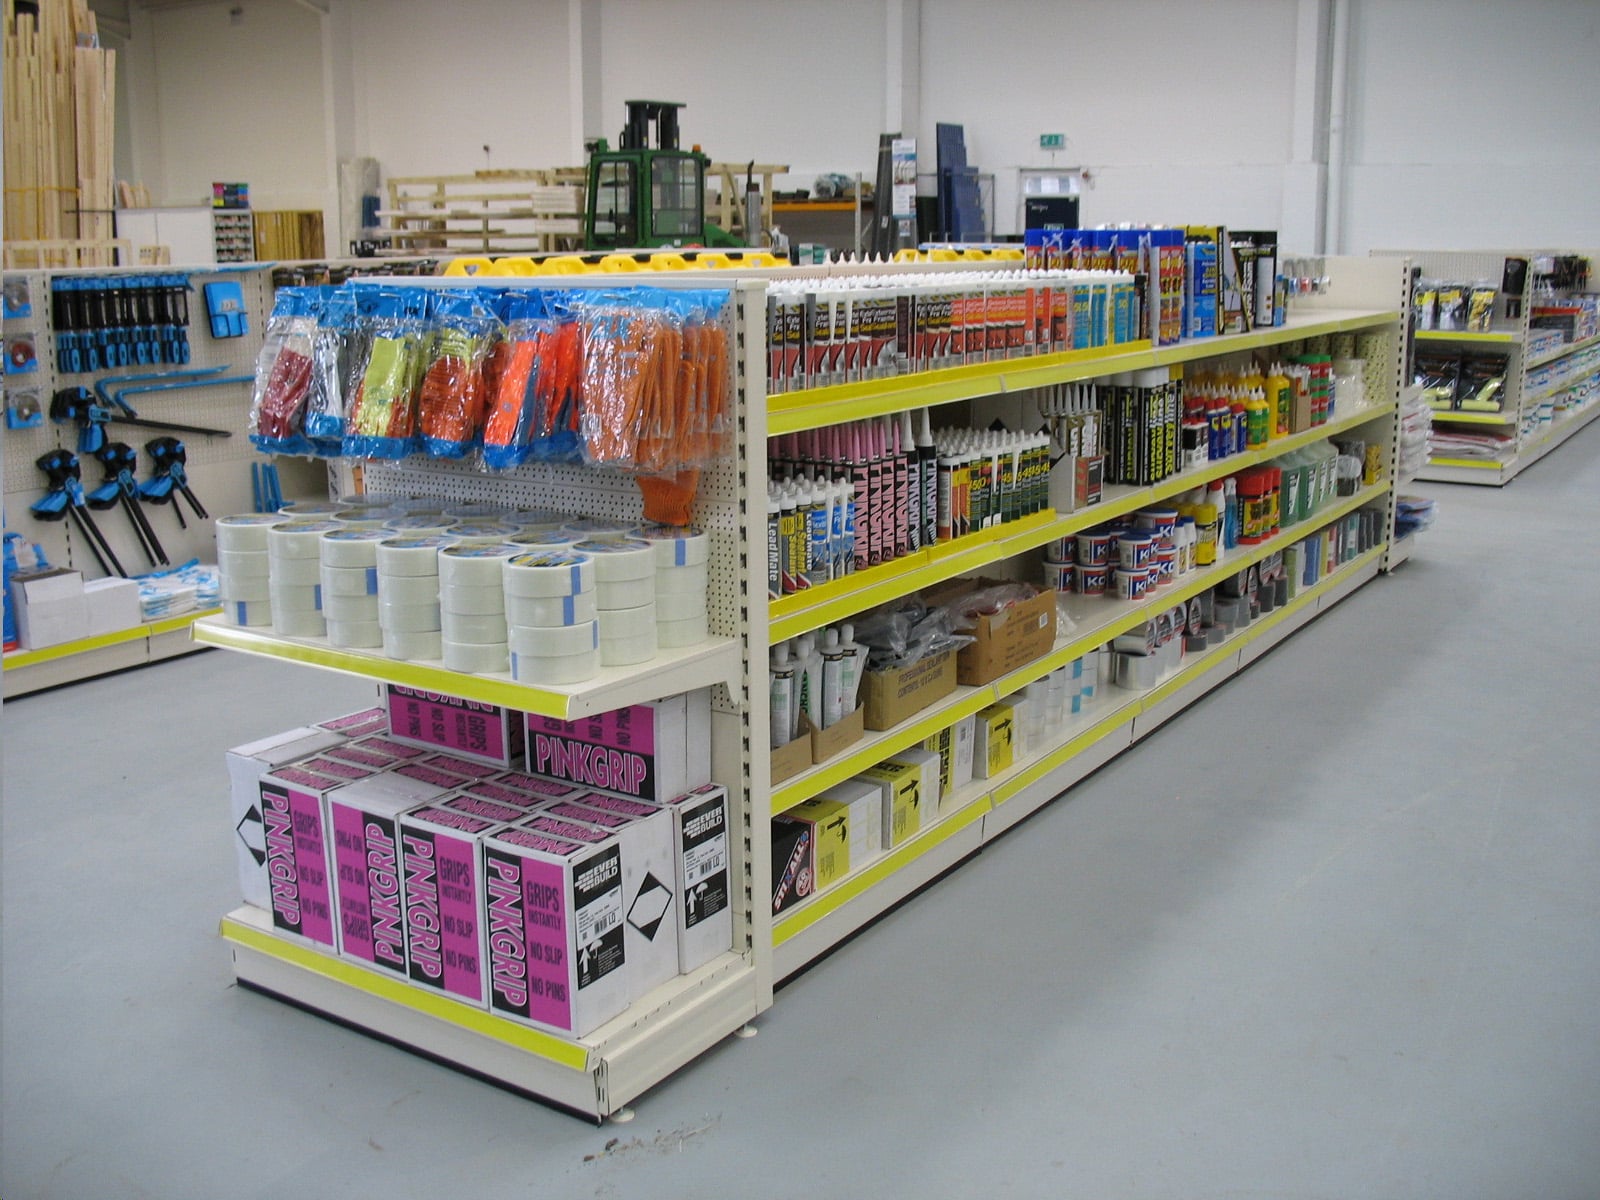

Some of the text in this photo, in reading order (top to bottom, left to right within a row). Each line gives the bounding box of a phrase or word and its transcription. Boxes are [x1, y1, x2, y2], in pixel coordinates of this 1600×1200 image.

[768, 522, 778, 581] LeadMate
[535, 733, 647, 795] PINKGRIP
[700, 805, 722, 824] EVER
[701, 815, 723, 833] BUILD
[262, 791, 301, 925] PINKGRIP
[439, 855, 470, 887] GRIPS
[593, 855, 618, 876] EVER
[594, 866, 618, 886] BUILD
[365, 822, 404, 965] PINKGRIP
[402, 834, 442, 979] PINKGRIP
[526, 880, 559, 913] GRIPS
[443, 914, 473, 939] NO SLIP
[488, 857, 527, 1007] PINKGRIP
[528, 909, 562, 931] INSTANTLY
[445, 948, 477, 974] NO PINS
[530, 941, 563, 966] NO SLIP
[531, 976, 566, 1003] NO PINS
